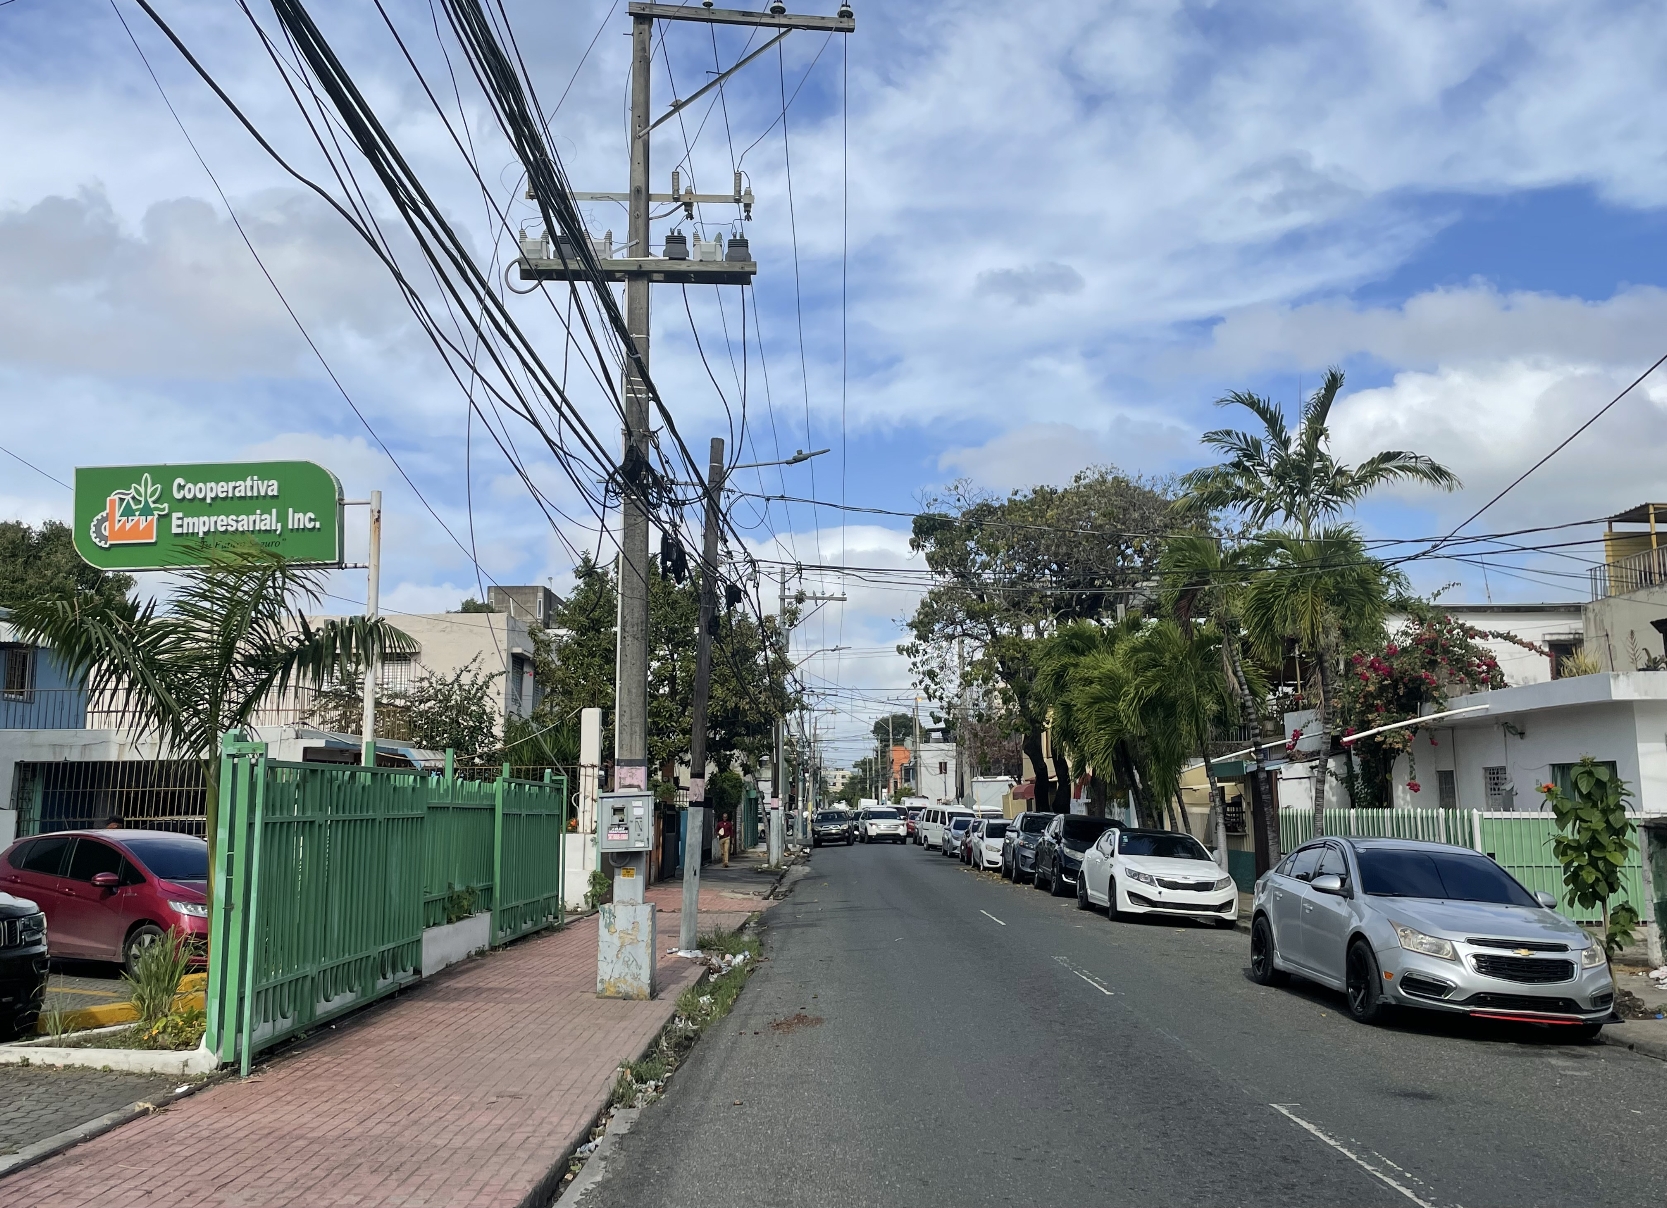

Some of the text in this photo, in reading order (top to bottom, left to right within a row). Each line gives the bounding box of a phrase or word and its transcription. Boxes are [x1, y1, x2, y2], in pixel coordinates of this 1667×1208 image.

[172, 475, 279, 503] Cooperativa
[171, 507, 320, 537] Empresarial, Inc.
